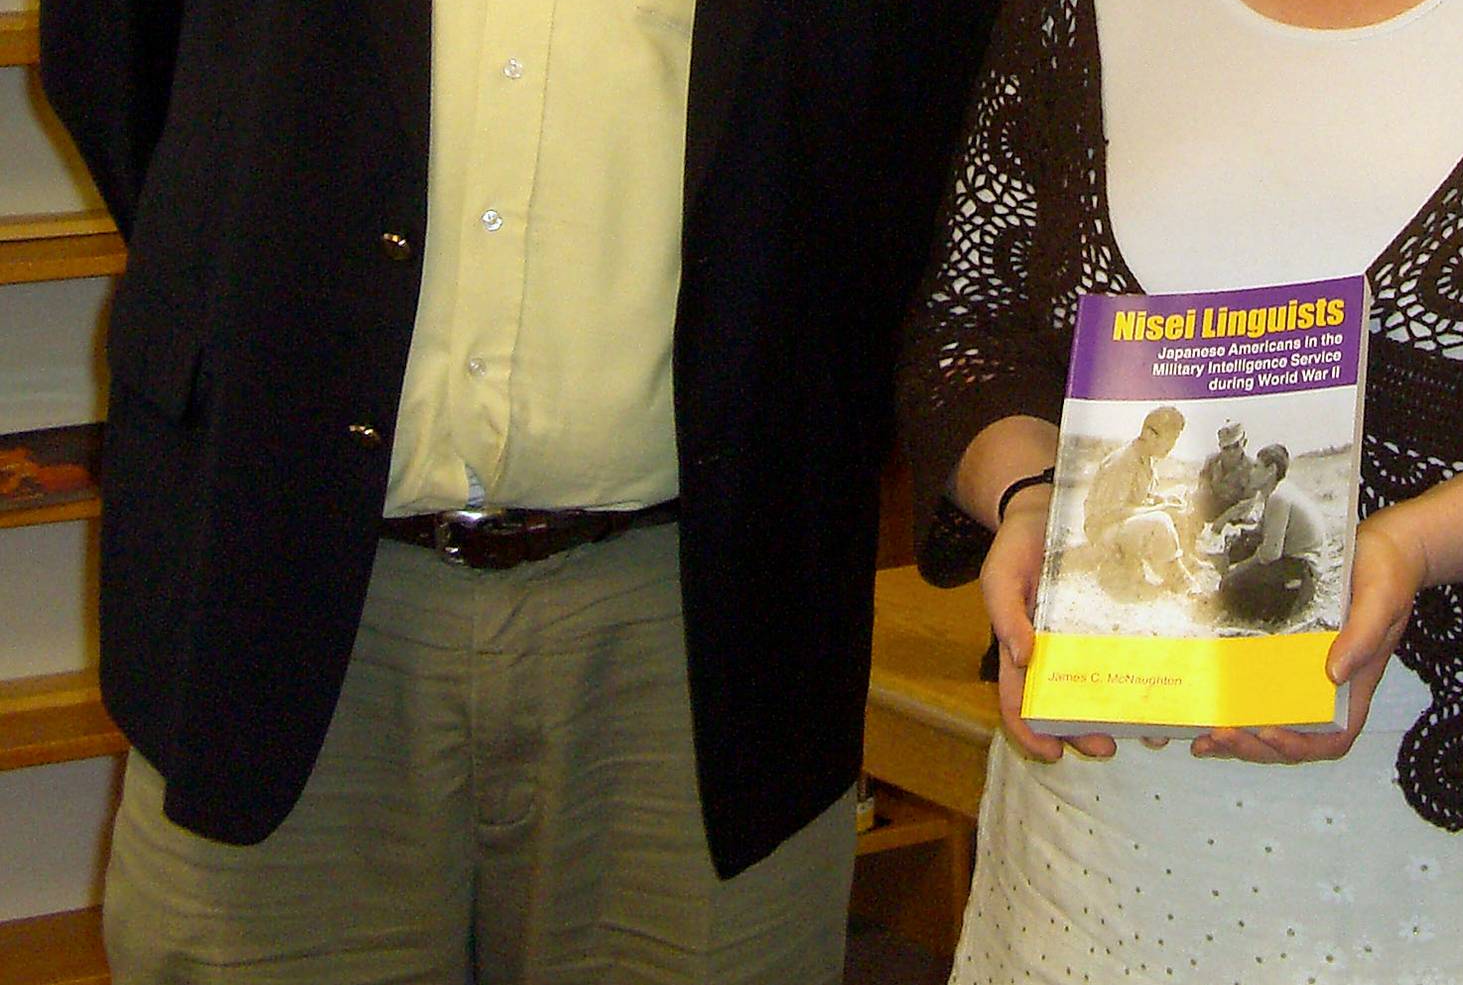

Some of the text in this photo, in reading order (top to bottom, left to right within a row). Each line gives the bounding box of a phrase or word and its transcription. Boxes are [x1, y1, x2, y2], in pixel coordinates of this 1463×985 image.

[1112, 297, 1345, 342] Nisei Linguists
[1157, 332, 1344, 362] Japanese Americans in the
[1152, 351, 1342, 378] Military Intelligence Service
[1208, 365, 1341, 392] during World War II
[1047, 672, 1183, 687] James C. McNaughton
